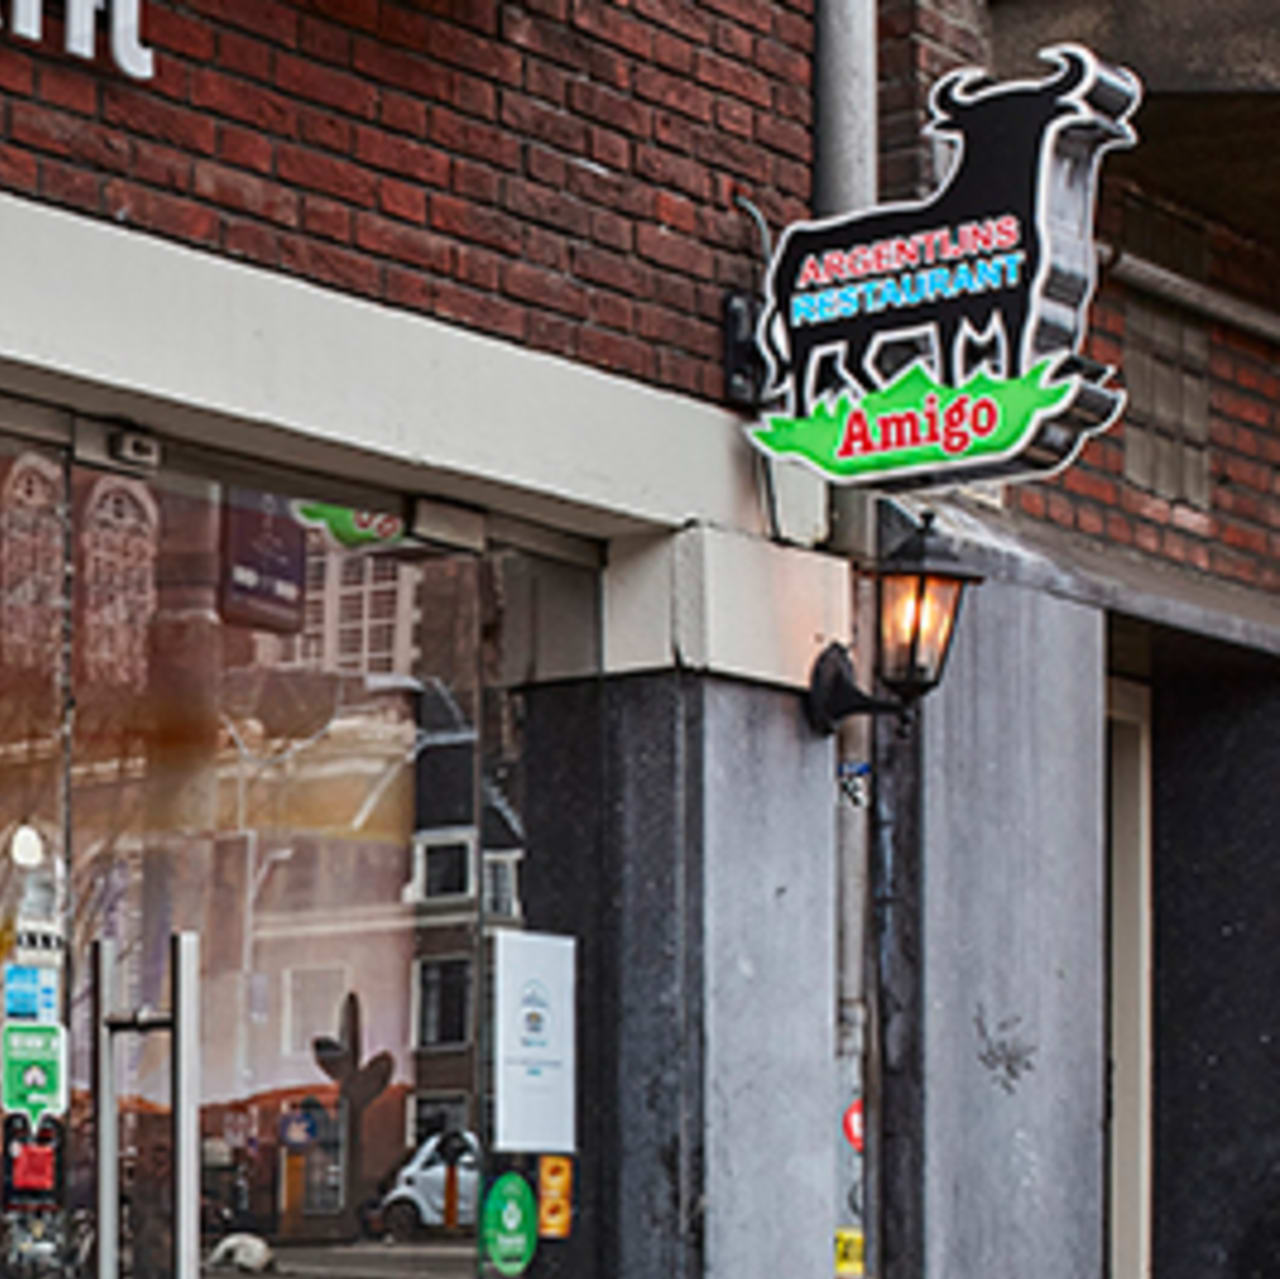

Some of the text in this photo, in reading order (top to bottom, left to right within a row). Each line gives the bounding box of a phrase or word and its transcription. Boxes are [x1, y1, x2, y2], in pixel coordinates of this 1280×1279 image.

[789, 251, 1025, 327] RESTAURANT
[795, 214, 1020, 289] ARGENTIJNS
[836, 393, 999, 458] Amigo
